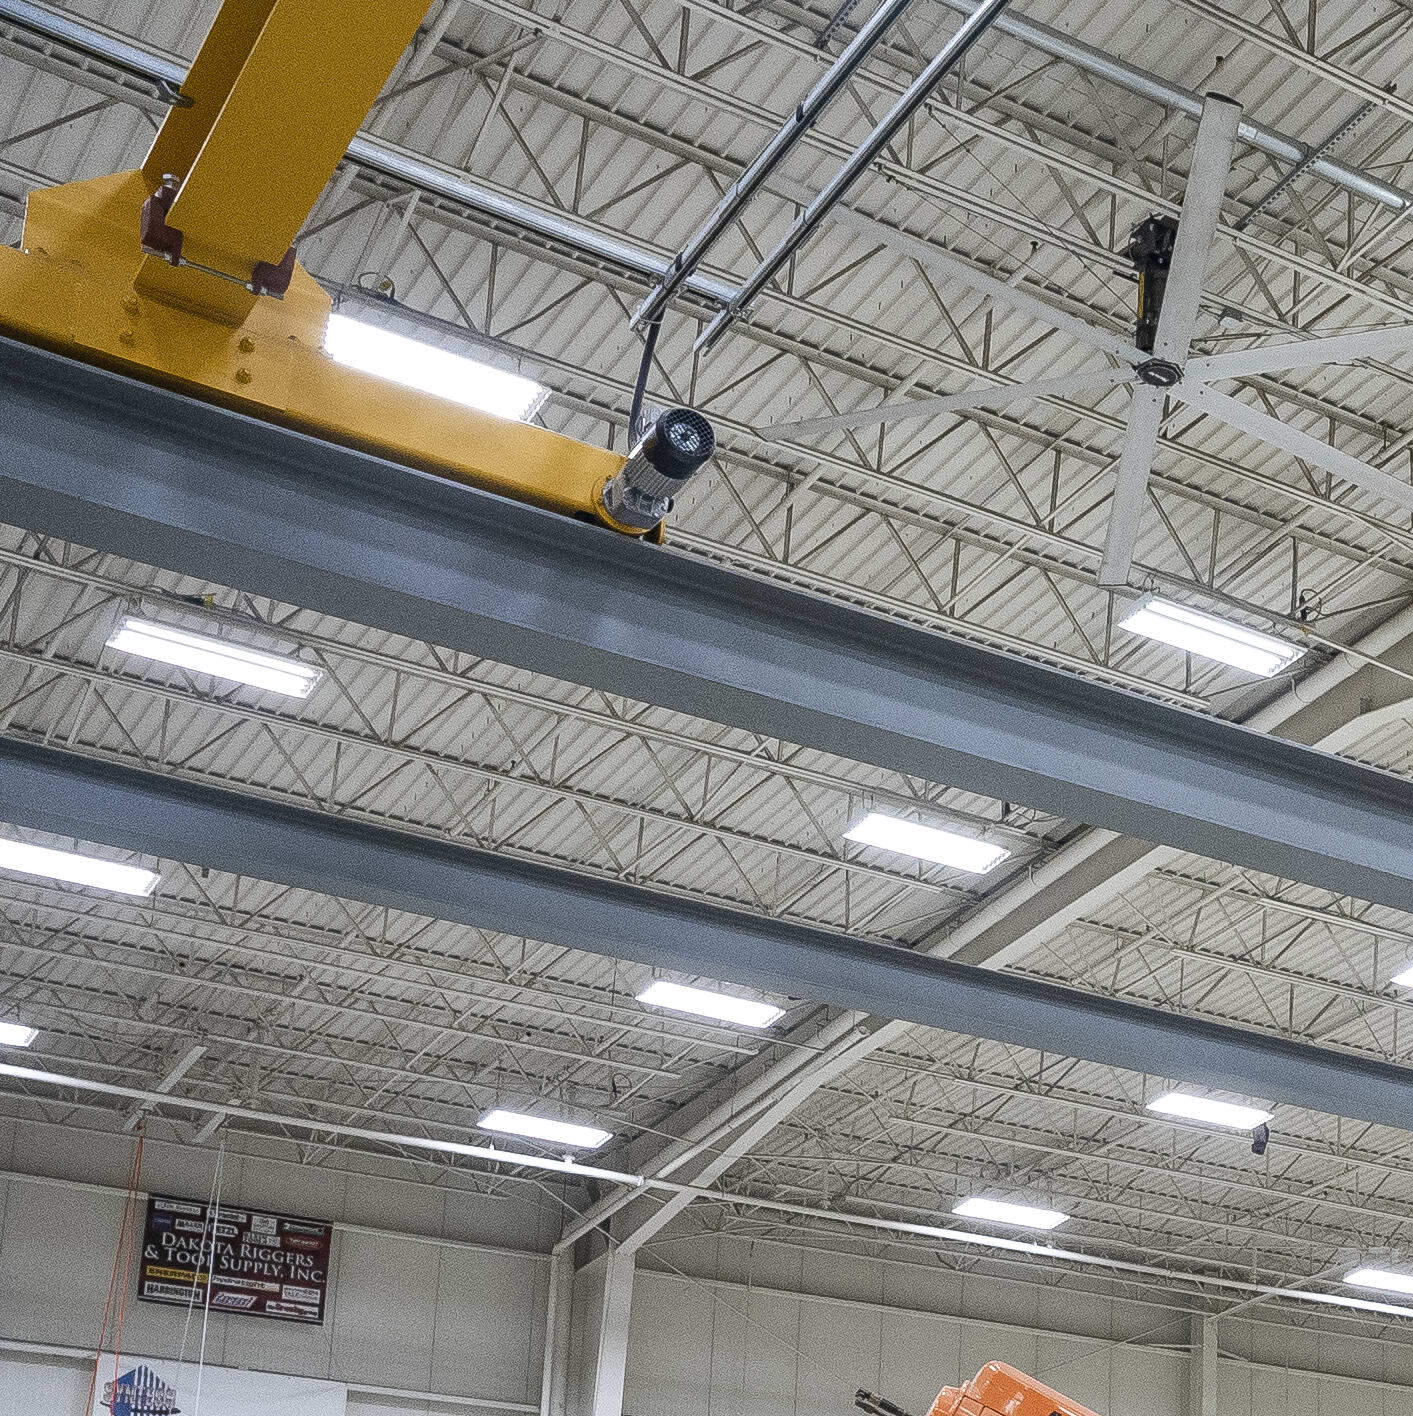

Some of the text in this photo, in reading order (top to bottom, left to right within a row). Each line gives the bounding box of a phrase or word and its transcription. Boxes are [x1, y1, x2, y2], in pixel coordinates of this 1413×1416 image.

[144, 1244, 159, 1260] &
[220, 1255, 284, 1278] SUPPLY,
[161, 1232, 234, 1256] DAKOTA
[240, 1243, 314, 1267] RIGGERS
